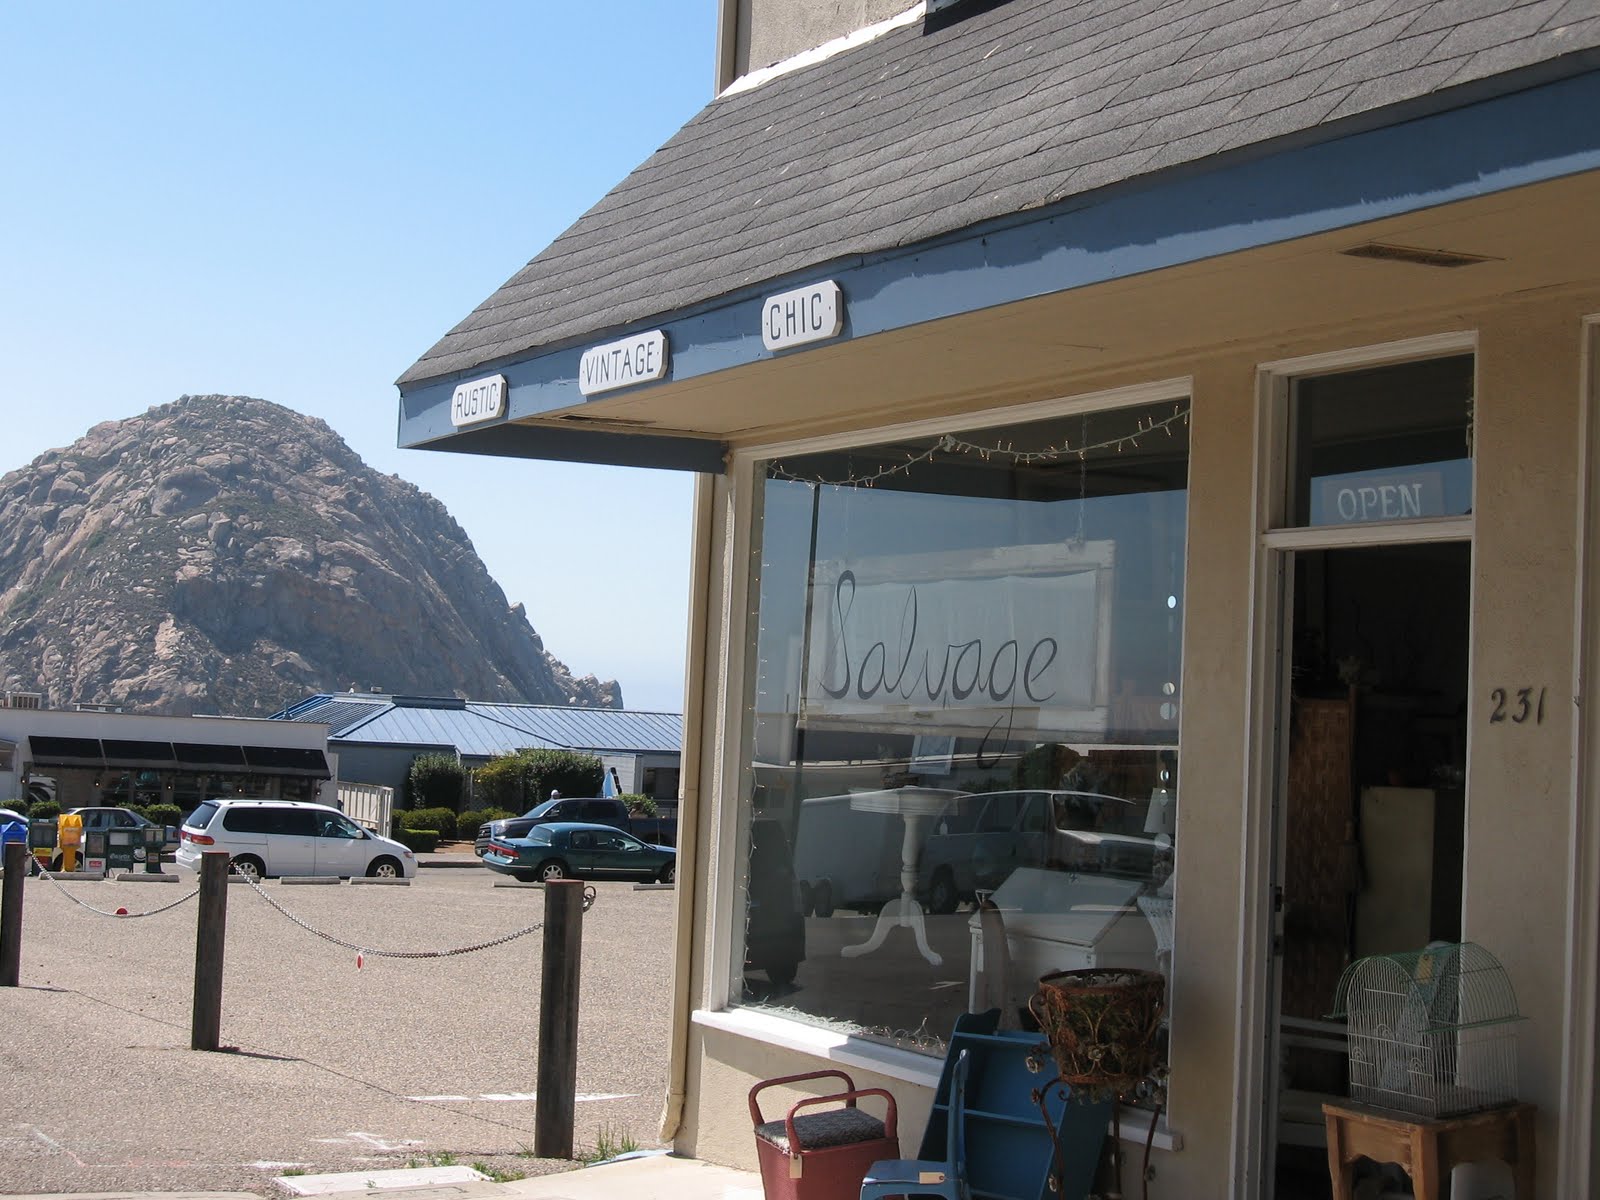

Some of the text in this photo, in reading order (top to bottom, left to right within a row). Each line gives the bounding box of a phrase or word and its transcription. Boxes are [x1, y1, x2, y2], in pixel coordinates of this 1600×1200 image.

[770, 293, 822, 340] CHIC
[586, 341, 655, 385] VINTAGE
[455, 383, 497, 419] RUSTIC
[1337, 483, 1423, 520] OPEN
[818, 569, 1058, 769] Salvage
[1489, 687, 1546, 726] 231
